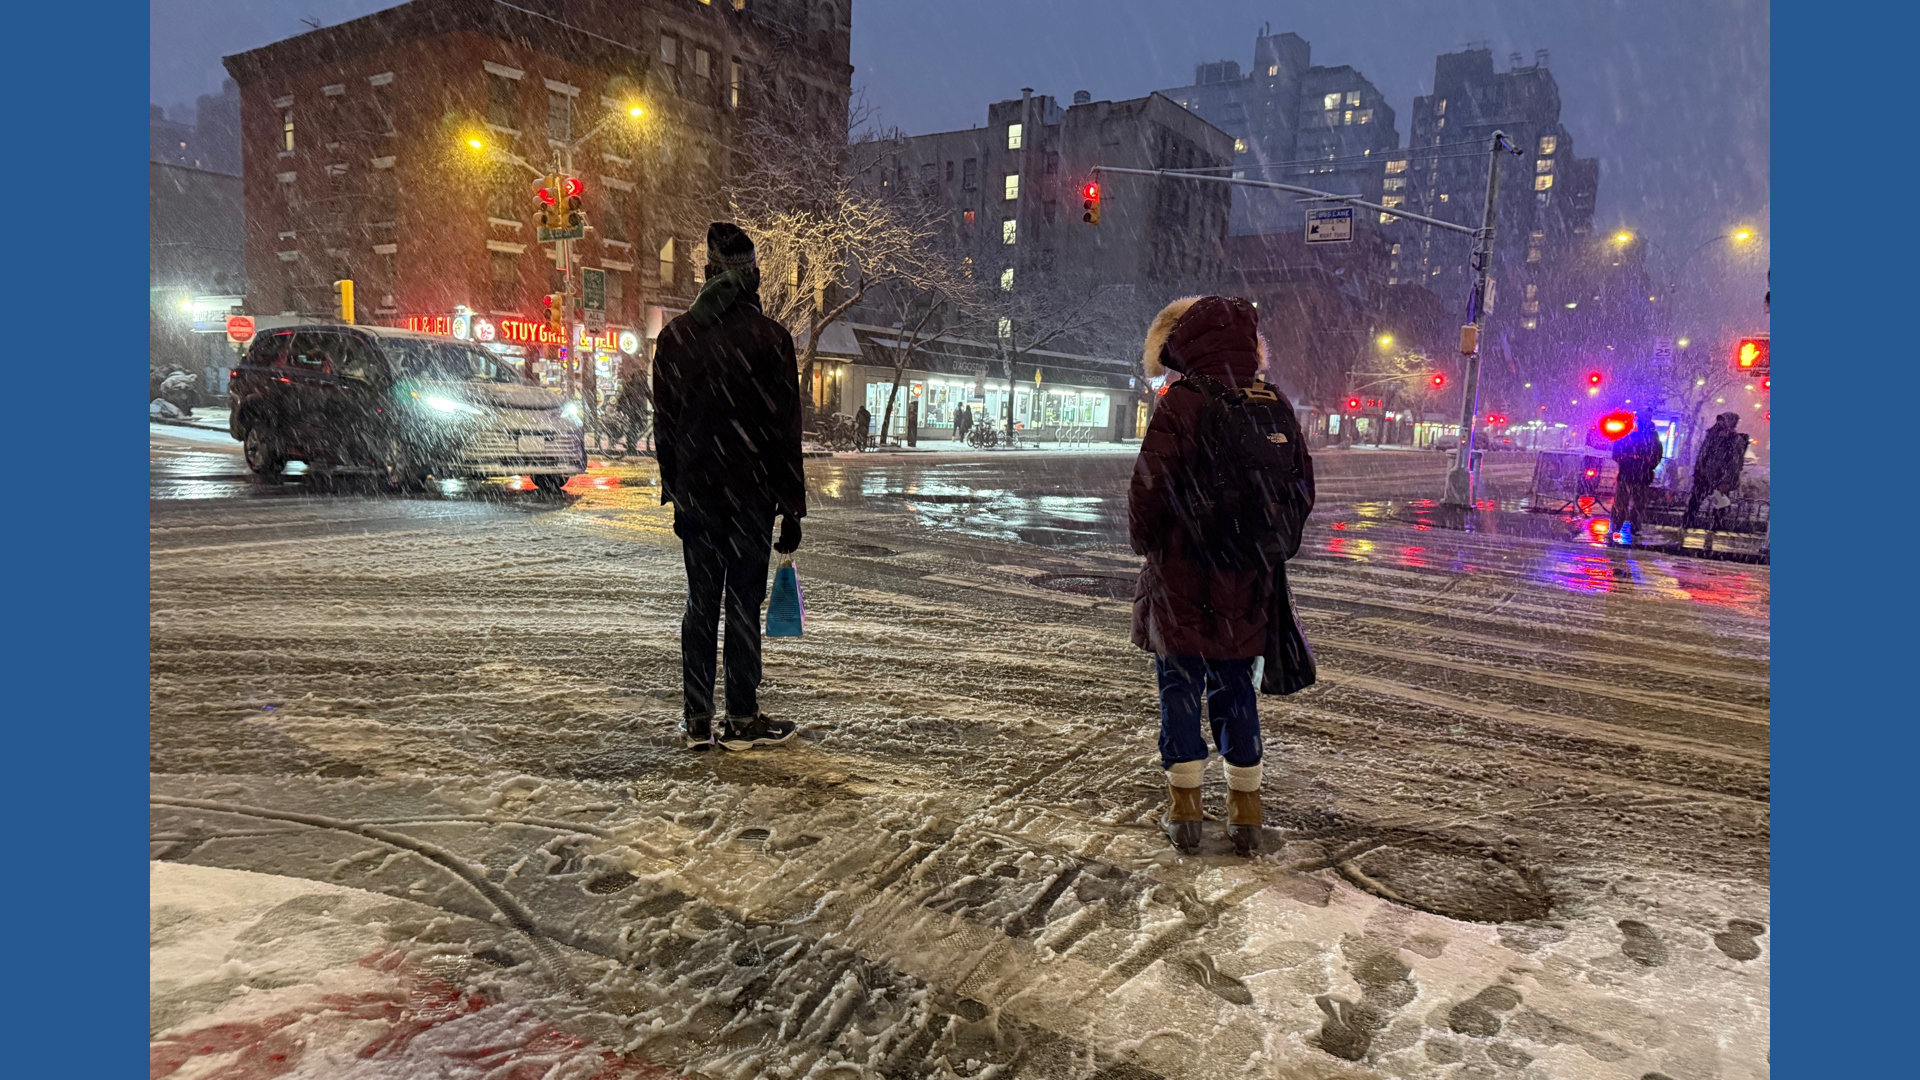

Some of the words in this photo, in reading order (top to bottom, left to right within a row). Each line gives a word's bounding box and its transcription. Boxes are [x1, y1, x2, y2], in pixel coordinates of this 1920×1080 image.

[588, 312, 601, 321] ALL
[501, 320, 538, 342] STUY
[579, 327, 589, 346] &
